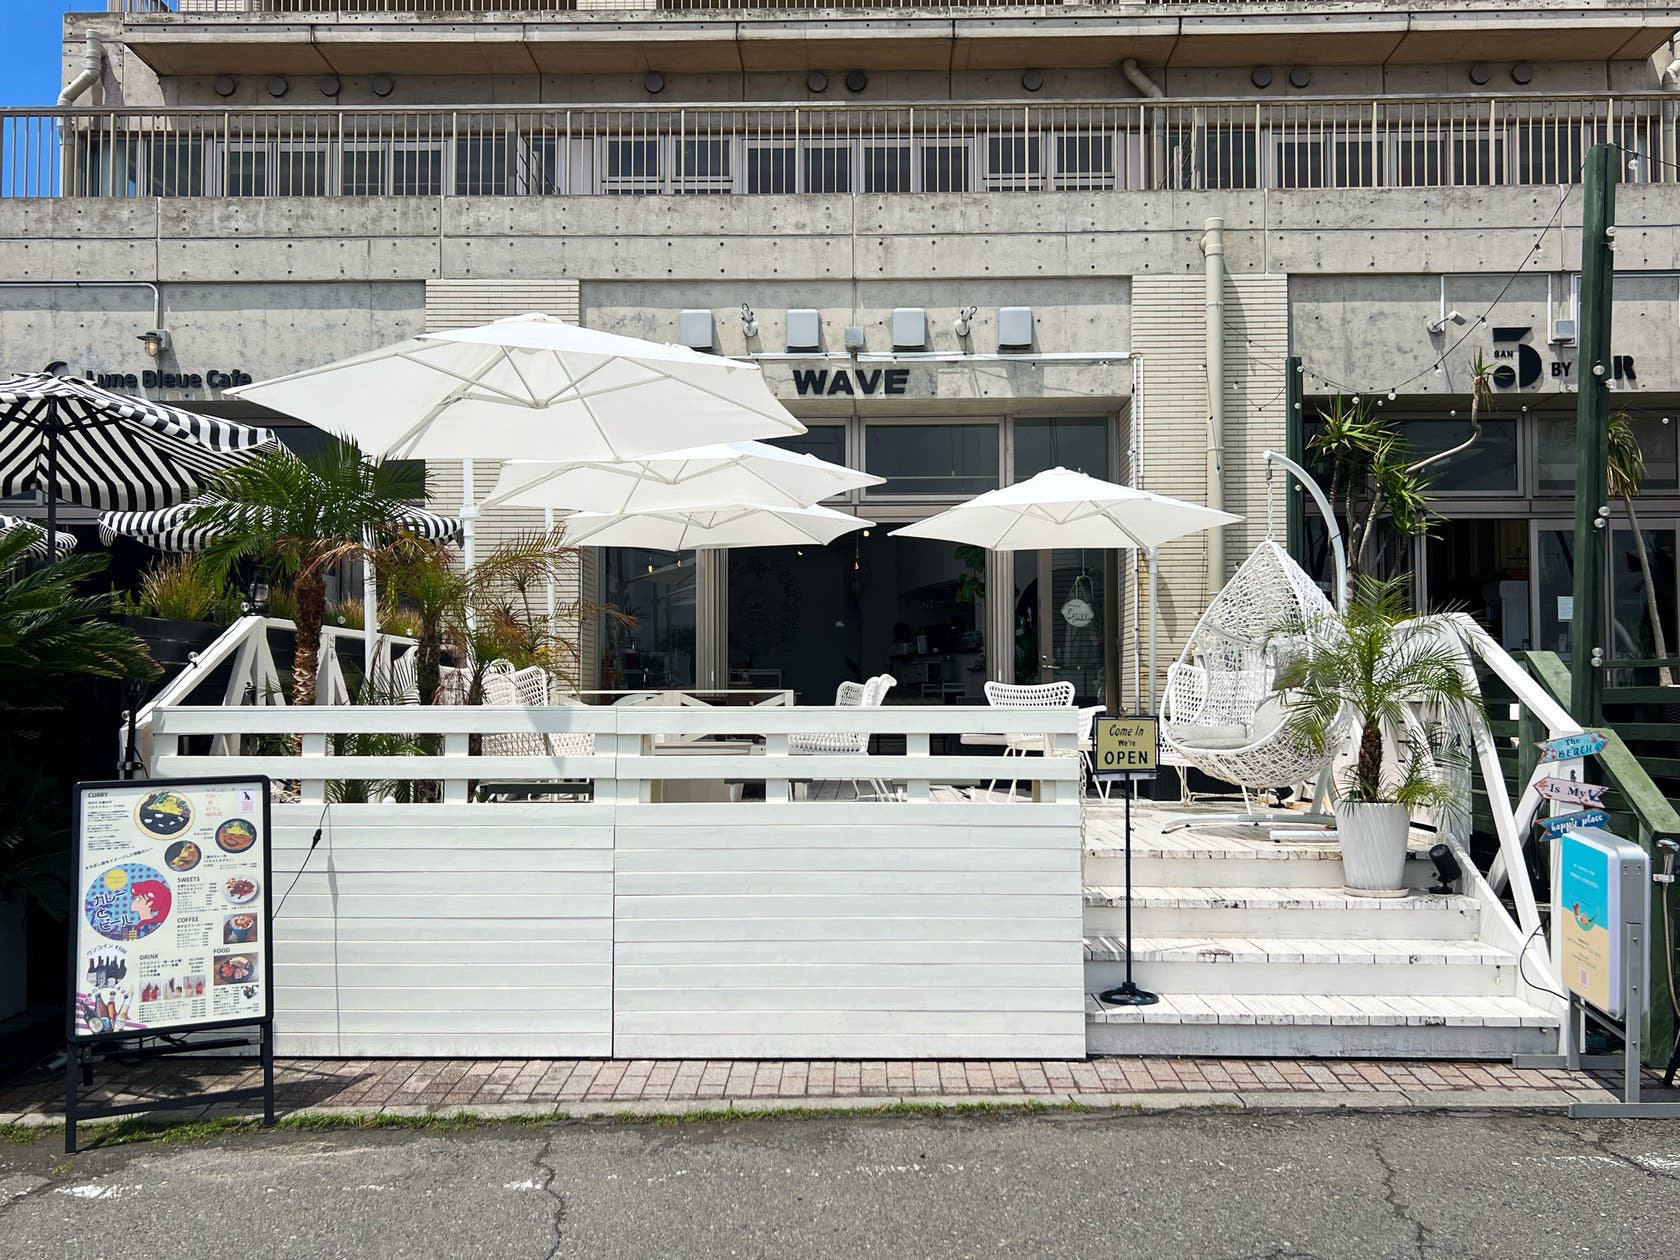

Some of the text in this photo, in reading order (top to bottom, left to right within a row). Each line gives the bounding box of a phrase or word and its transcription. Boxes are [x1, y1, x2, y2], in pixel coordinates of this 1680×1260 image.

[1493, 350, 1514, 359] SAN
[1551, 361, 1573, 377] BY
[142, 370, 202, 388] Bleue
[792, 369, 910, 395] WAVE
[1109, 724, 1144, 737] Come In
[1117, 739, 1136, 747] We're
[1104, 750, 1148, 765] OPEN
[1550, 783, 1587, 799] Is My
[93, 890, 127, 906] カレー
[97, 907, 108, 919] と
[99, 914, 133, 931] ビール
[139, 953, 159, 961] DRINK
